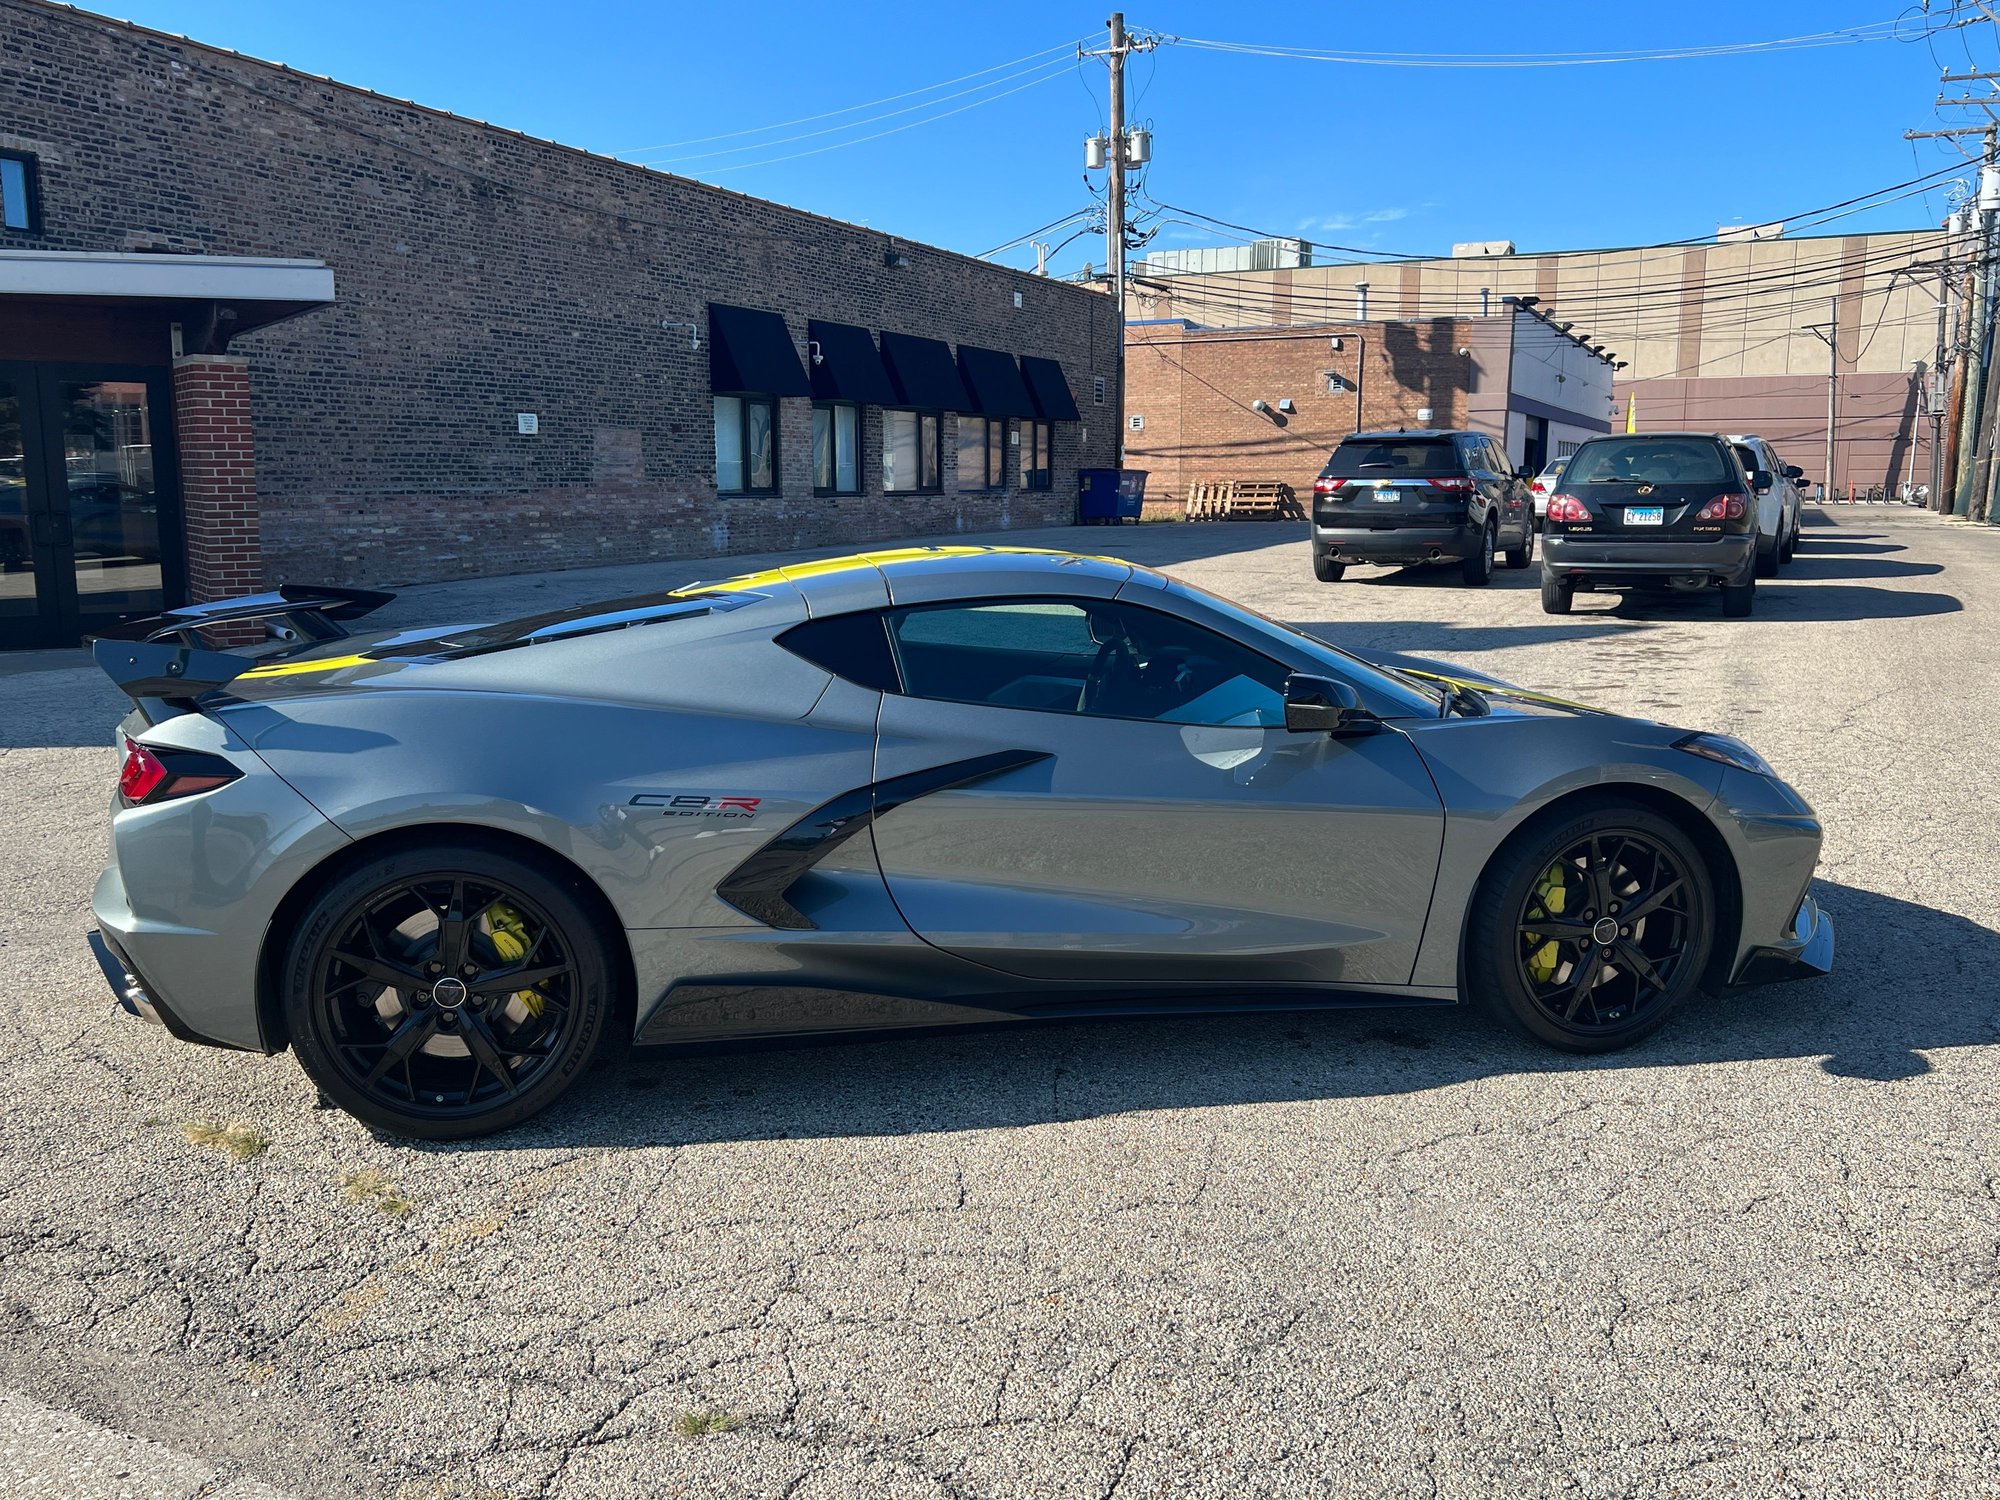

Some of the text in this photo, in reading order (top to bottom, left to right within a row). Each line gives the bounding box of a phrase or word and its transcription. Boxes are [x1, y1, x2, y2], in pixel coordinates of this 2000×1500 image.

[1626, 511, 1662, 521] CY 21258
[662, 811, 756, 819] EDITION
